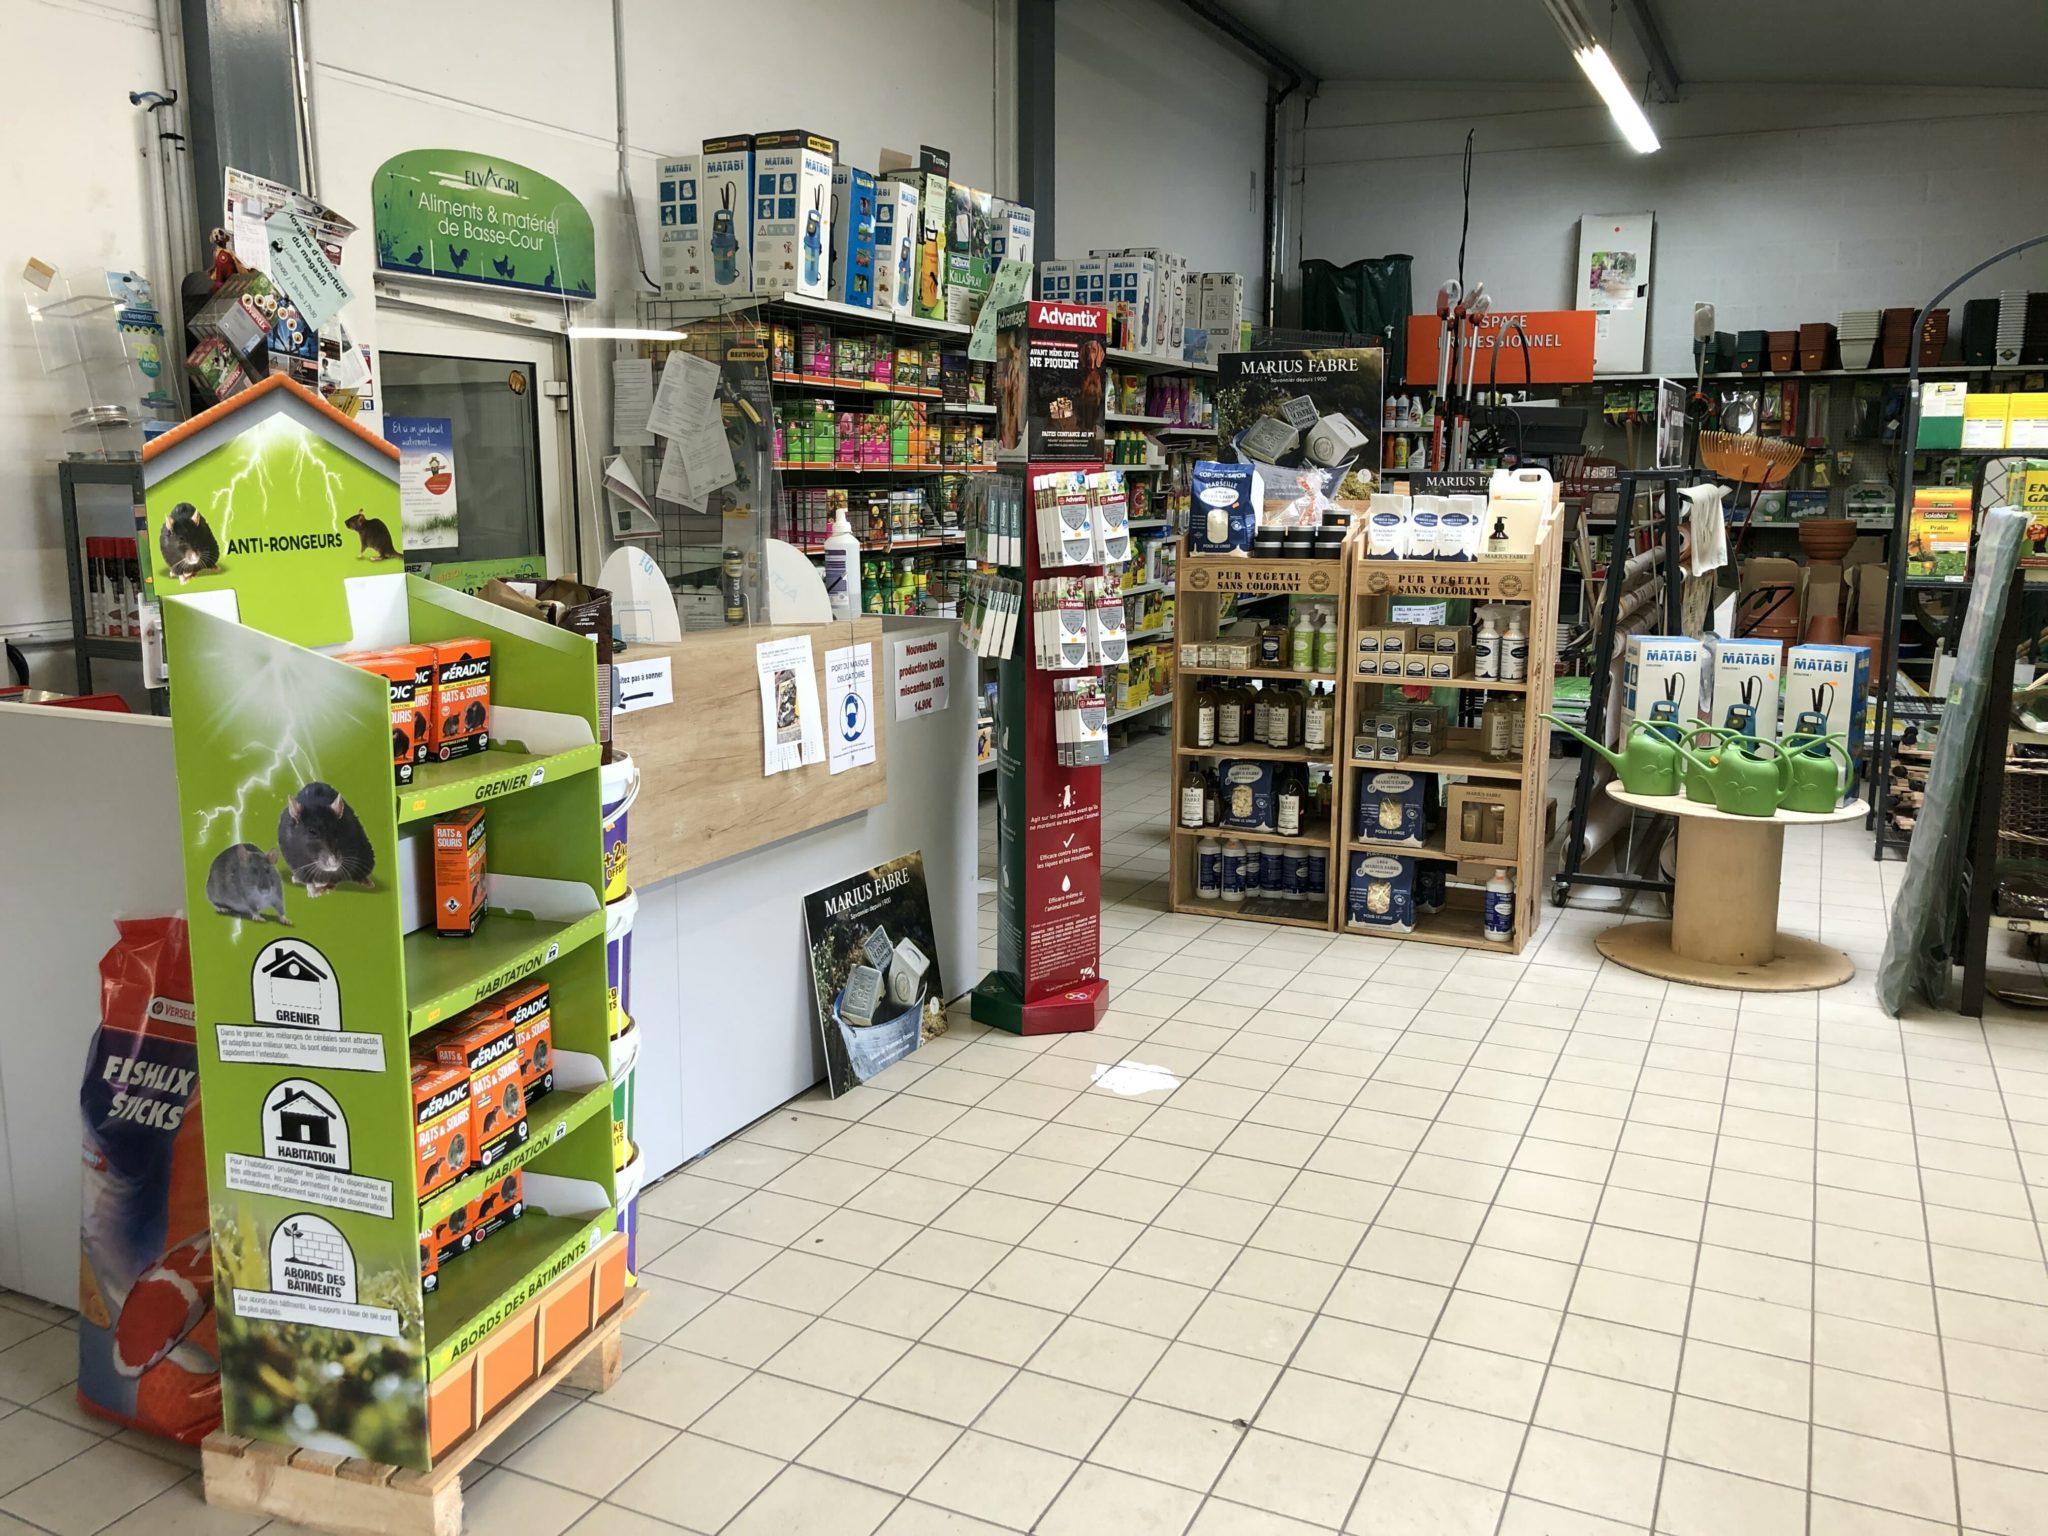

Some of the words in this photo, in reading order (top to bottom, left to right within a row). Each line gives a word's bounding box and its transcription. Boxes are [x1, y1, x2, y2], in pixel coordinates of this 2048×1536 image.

[707, 160, 744, 173] MATABI
[465, 166, 519, 195] ELVAGRI
[418, 192, 484, 221] Aliments
[487, 205, 499, 225] &
[502, 210, 559, 235] matériel
[438, 218, 460, 237] de
[464, 221, 544, 251] Basse-Cour
[291, 235, 303, 249] du
[300, 248, 328, 287] magasin
[998, 307, 1028, 329] Advantage
[1038, 306, 1098, 328] Advantix
[1480, 314, 1528, 329] SPACE
[1029, 348, 1048, 357] AVANT
[1029, 357, 1043, 368] NE
[1044, 357, 1080, 370] PIQUENT
[1240, 359, 1303, 375] MARIUS
[1308, 358, 1359, 373] FABRE
[1295, 375, 1314, 385] depuis
[1205, 481, 1238, 489] MARSEILLE
[1426, 476, 1476, 488] MARIUS
[227, 532, 343, 556] ANTI-RONGEURS
[1217, 571, 1242, 581] PUR
[1247, 571, 1301, 582] VEGETAL
[1217, 581, 1244, 591] SANS
[1245, 581, 1301, 592] COLORANT
[1398, 574, 1425, 585] PUR
[1431, 575, 1491, 586] VEGETAL
[1398, 585, 1427, 595] SANS
[1429, 586, 1491, 597] COLORANT
[905, 640, 938, 657] Nouveautée
[1646, 649, 1698, 663] MATABI
[1722, 651, 1776, 666] MATABI
[448, 659, 489, 680] ÉRADIC
[830, 664, 843, 673] PORT
[842, 663, 850, 672] DU
[850, 658, 870, 670] MASQUE
[898, 662, 929, 681] production
[928, 657, 945, 672] locale
[1793, 657, 1849, 673] MATABI
[836, 670, 866, 684] OBLIGATOIRE
[440, 690, 459, 705] RATS
[459, 691, 465, 701] &
[466, 684, 488, 700] SOURIS
[900, 682, 932, 696] miscanthus
[390, 710, 412, 724] OURIS
[474, 773, 528, 800] GRENIER
[437, 828, 456, 838] RATS
[437, 837, 463, 848] SOURIS
[824, 882, 873, 918] MARIUS
[875, 867, 910, 896] FABRE
[880, 897, 892, 908] 1900
[474, 953, 543, 1002] HABITATION
[276, 1009, 320, 1026] GRENIER
[516, 995, 549, 1024] ÉRADIC
[220, 1028, 236, 1037] Dans
[236, 1030, 243, 1038] le
[265, 1030, 275, 1039] les
[275, 1031, 303, 1042] mélanges
[304, 1033, 312, 1041] de
[313, 1033, 338, 1043] céréales
[352, 1036, 379, 1046] attractifs
[222, 1049, 255, 1059] rapidement
[477, 1033, 515, 1067] ÉRADIC
[103, 1054, 196, 1097] FISHLIX
[473, 1076, 491, 1097] RATS
[491, 1073, 498, 1086] &
[497, 1059, 520, 1082] SOURIS
[428, 1081, 469, 1115] ÉRADIC
[107, 1093, 185, 1132] STICKS
[419, 1125, 439, 1148] RATS
[439, 1124, 446, 1136] &
[446, 1106, 470, 1131] SOURIS
[278, 1145, 336, 1165] HABITATION
[484, 1135, 551, 1188] HABITATION
[230, 1156, 243, 1166] Pour
[305, 1169, 314, 1178] les
[333, 1174, 345, 1183] Peu
[380, 1184, 387, 1192] et
[239, 1178, 271, 1190] infestations
[271, 1182, 307, 1197] efficacement
[307, 1188, 321, 1198] sans
[321, 1191, 338, 1203] risque
[338, 1195, 347, 1204] de
[273, 1174, 283, 1183] les
[283, 1176, 299, 1187] pâtes
[299, 1179, 330, 1192] permettent
[331, 1185, 339, 1193] de
[340, 1186, 369, 1199] neutraliser
[284, 1266, 324, 1282] ABORDS
[326, 1273, 346, 1286] DES
[287, 1277, 342, 1298] BÂTIMENTS
[237, 1294, 249, 1303] Aux
[249, 1296, 268, 1306] abords
[268, 1298, 279, 1307] des
[308, 1303, 317, 1312] les
[317, 1305, 341, 1316] supports
[347, 1308, 361, 1317] base
[369, 1311, 379, 1320] blé
[379, 1313, 392, 1322] sont
[238, 1303, 247, 1312] les
[246, 1305, 259, 1315] plus
[451, 1314, 501, 1361] ABORDS
[504, 1291, 526, 1317] DES
[527, 1241, 587, 1298] BÂTIMENTS
